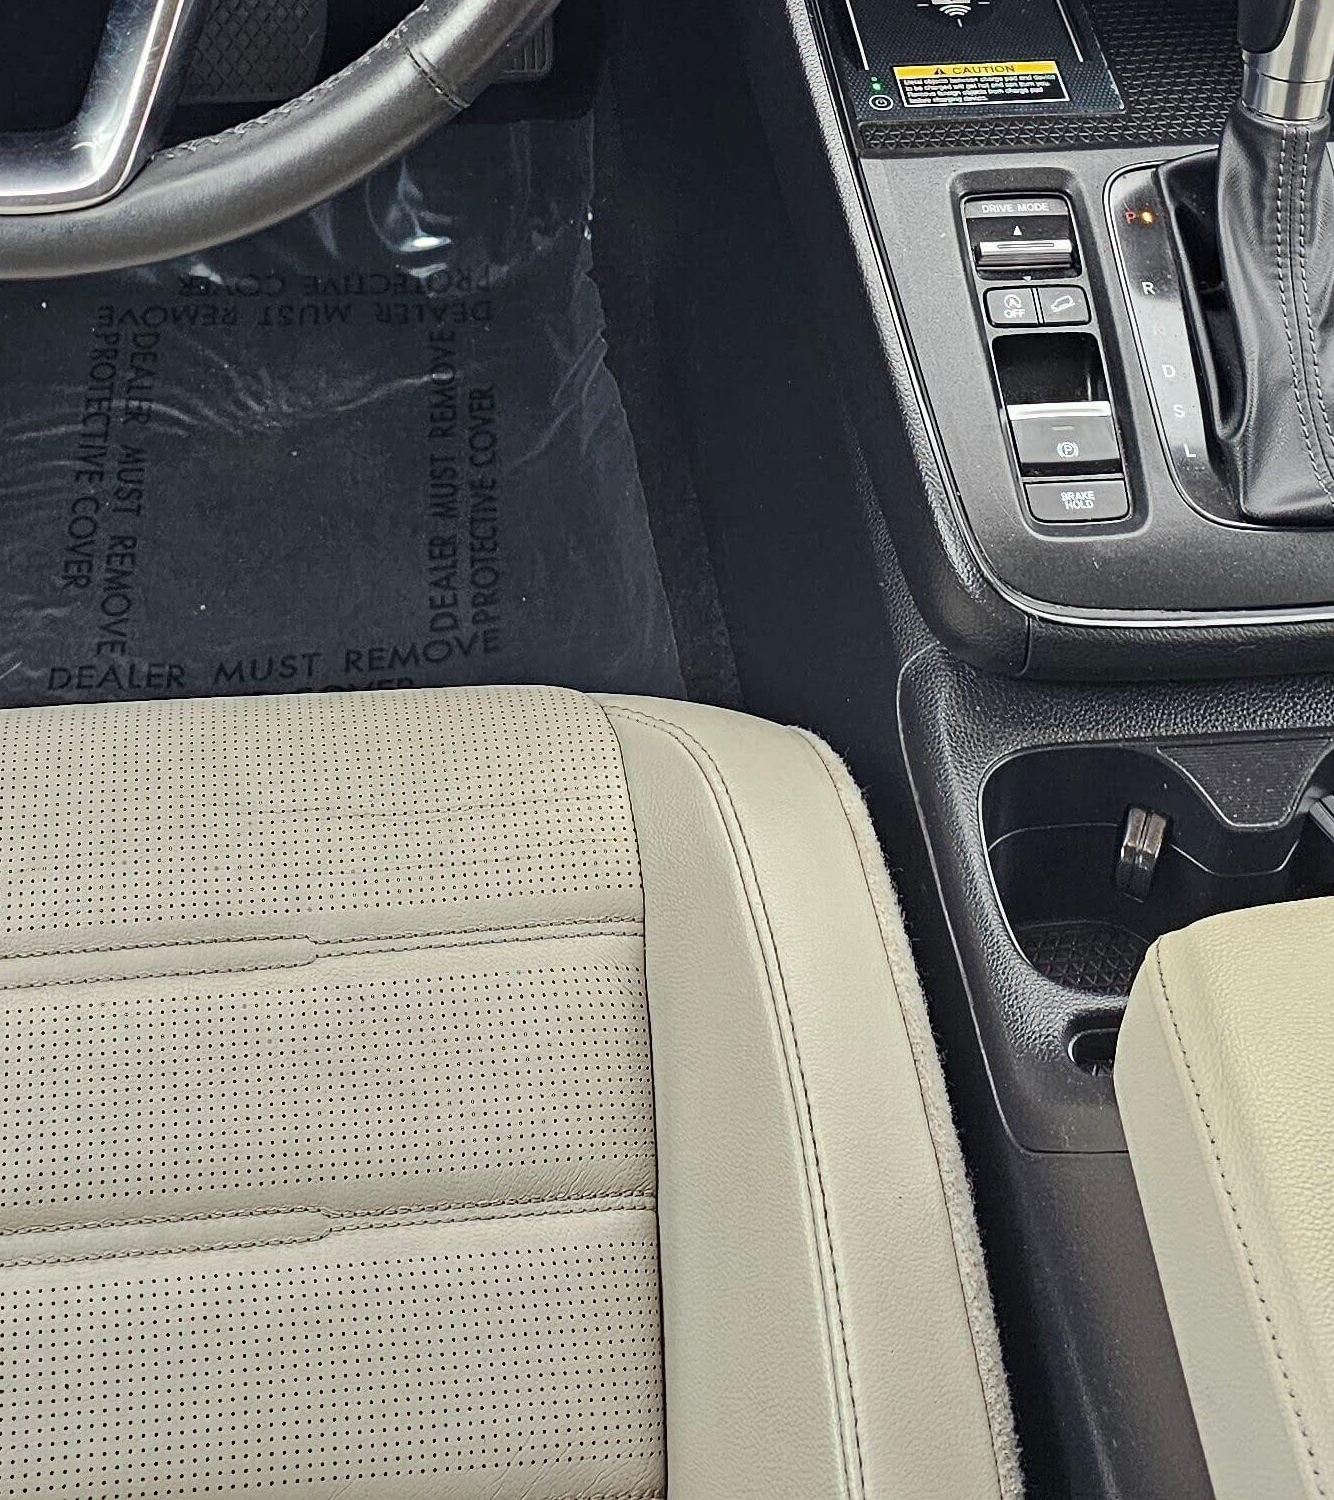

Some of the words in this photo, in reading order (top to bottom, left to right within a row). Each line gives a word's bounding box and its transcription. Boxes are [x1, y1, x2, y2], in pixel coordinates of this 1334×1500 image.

[952, 65, 1015, 75] CAUTION
[981, 203, 1013, 213] DRIVE
[1017, 202, 1050, 213] MODE
[1125, 212, 1136, 224] P
[1142, 282, 1155, 295] R
[1004, 308, 1025, 318] OFF
[428, 329, 457, 440] REMOVE
[1162, 365, 1176, 377] D
[73, 330, 120, 484] PROTECTIVE
[1173, 404, 1185, 417] S
[467, 386, 497, 470] COVER
[1185, 445, 1196, 458] L
[113, 445, 147, 517] MUST
[427, 450, 459, 521] MUST
[1060, 490, 1095, 502] BRAKE
[1065, 499, 1094, 510] HOLD
[63, 497, 101, 592] COVER
[470, 476, 501, 628] PROTECTIVE
[94, 533, 139, 656] REMOVE
[429, 531, 461, 637] DEALER
[47, 663, 186, 692] DEALER
[212, 651, 323, 687] MUST
[342, 629, 501, 674] REMOVE
